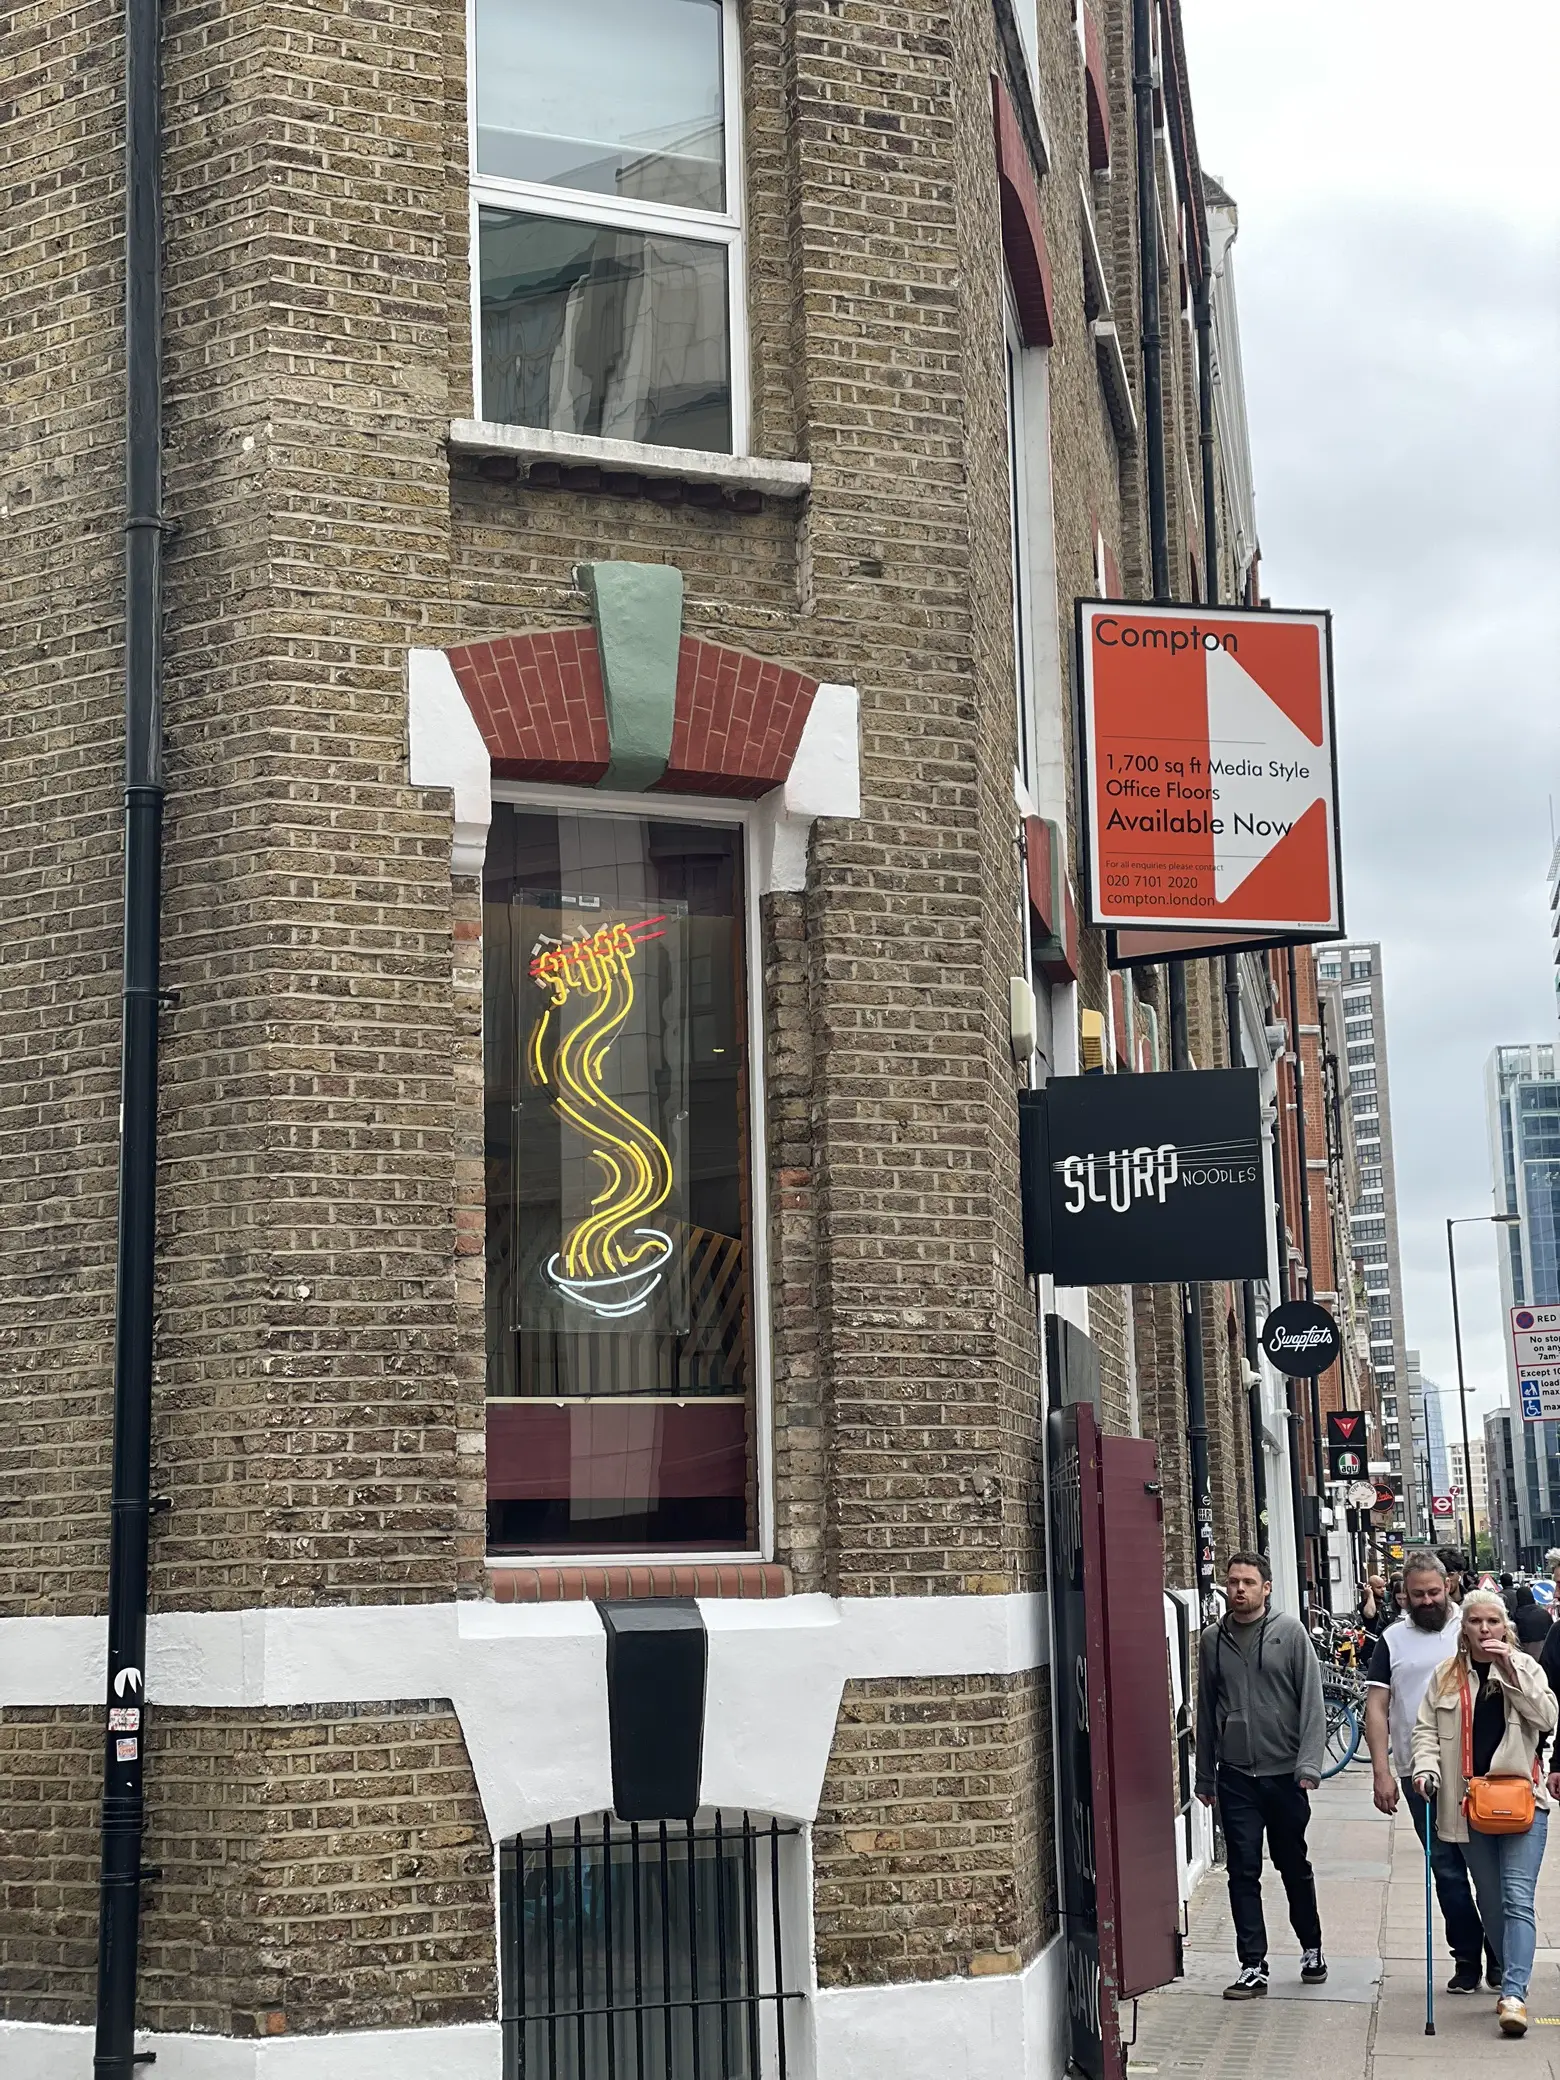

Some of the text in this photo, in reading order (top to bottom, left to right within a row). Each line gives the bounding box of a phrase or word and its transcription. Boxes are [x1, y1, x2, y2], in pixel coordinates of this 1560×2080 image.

[1095, 618, 1238, 655] Compton
[1106, 754, 1310, 782] 1,700 sq ft Media Style
[1106, 779, 1220, 800] Office Floors
[1106, 808, 1294, 837] Available Now
[1105, 860, 1224, 872] For all enquiries please contact
[1106, 874, 1198, 889] 020 7101 2020
[1107, 892, 1216, 907] compton.london
[1063, 1143, 1257, 1214] SLURP NOODLES
[1537, 1314, 1557, 1323] RED
[1269, 1324, 1334, 1352] Swapfiets
[1529, 1336, 1543, 1344] No
[1520, 1369, 1551, 1378] Except
